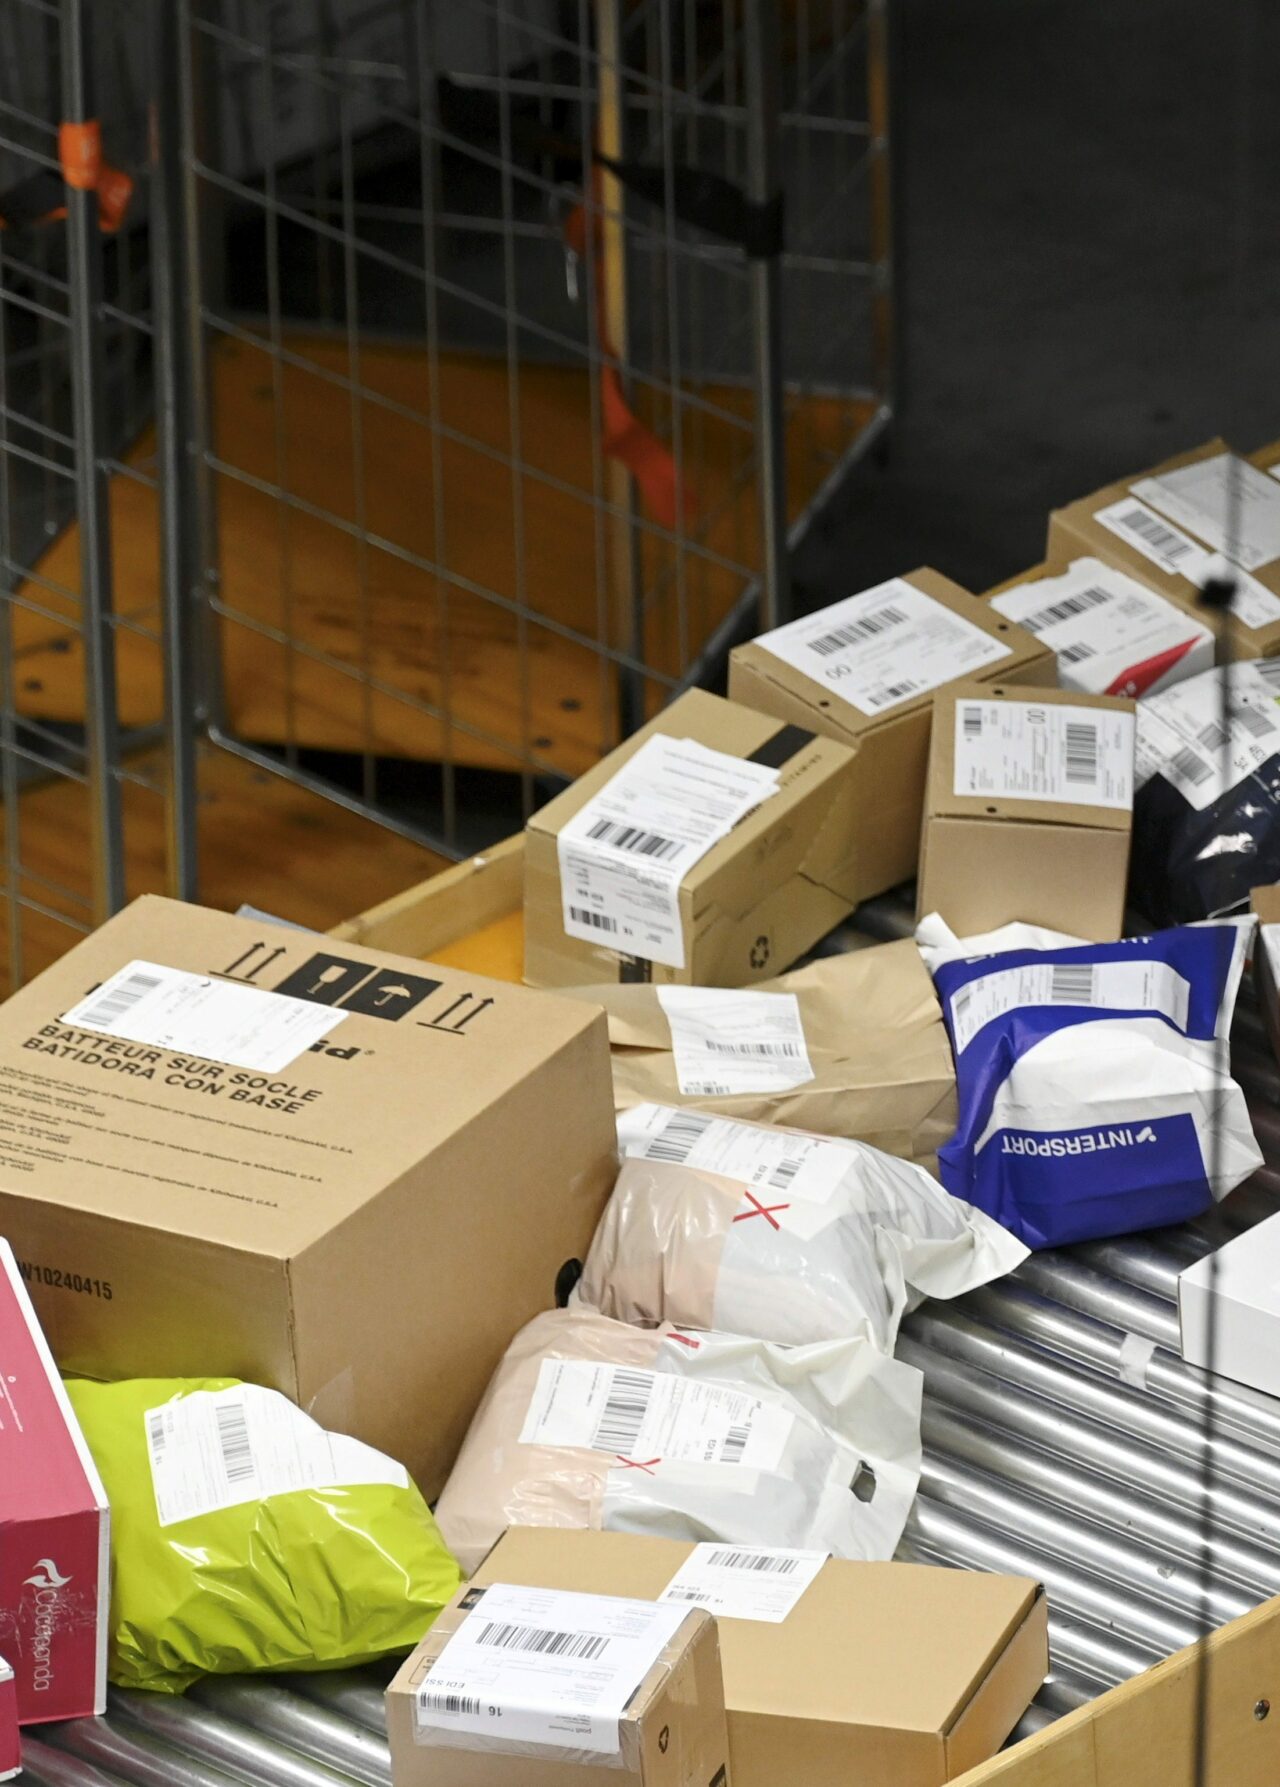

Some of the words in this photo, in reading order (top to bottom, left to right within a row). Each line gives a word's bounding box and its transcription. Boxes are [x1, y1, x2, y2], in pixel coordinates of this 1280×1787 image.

[22, 1037, 155, 1080] BATIDORA
[164, 1074, 226, 1096] CON
[228, 1088, 306, 1115] BASE
[38, 1025, 162, 1065] BATTEUR
[167, 1056, 226, 1080] SUR
[228, 1070, 323, 1102] SOCLE
[1001, 1128, 1134, 1158] INTERSPORT
